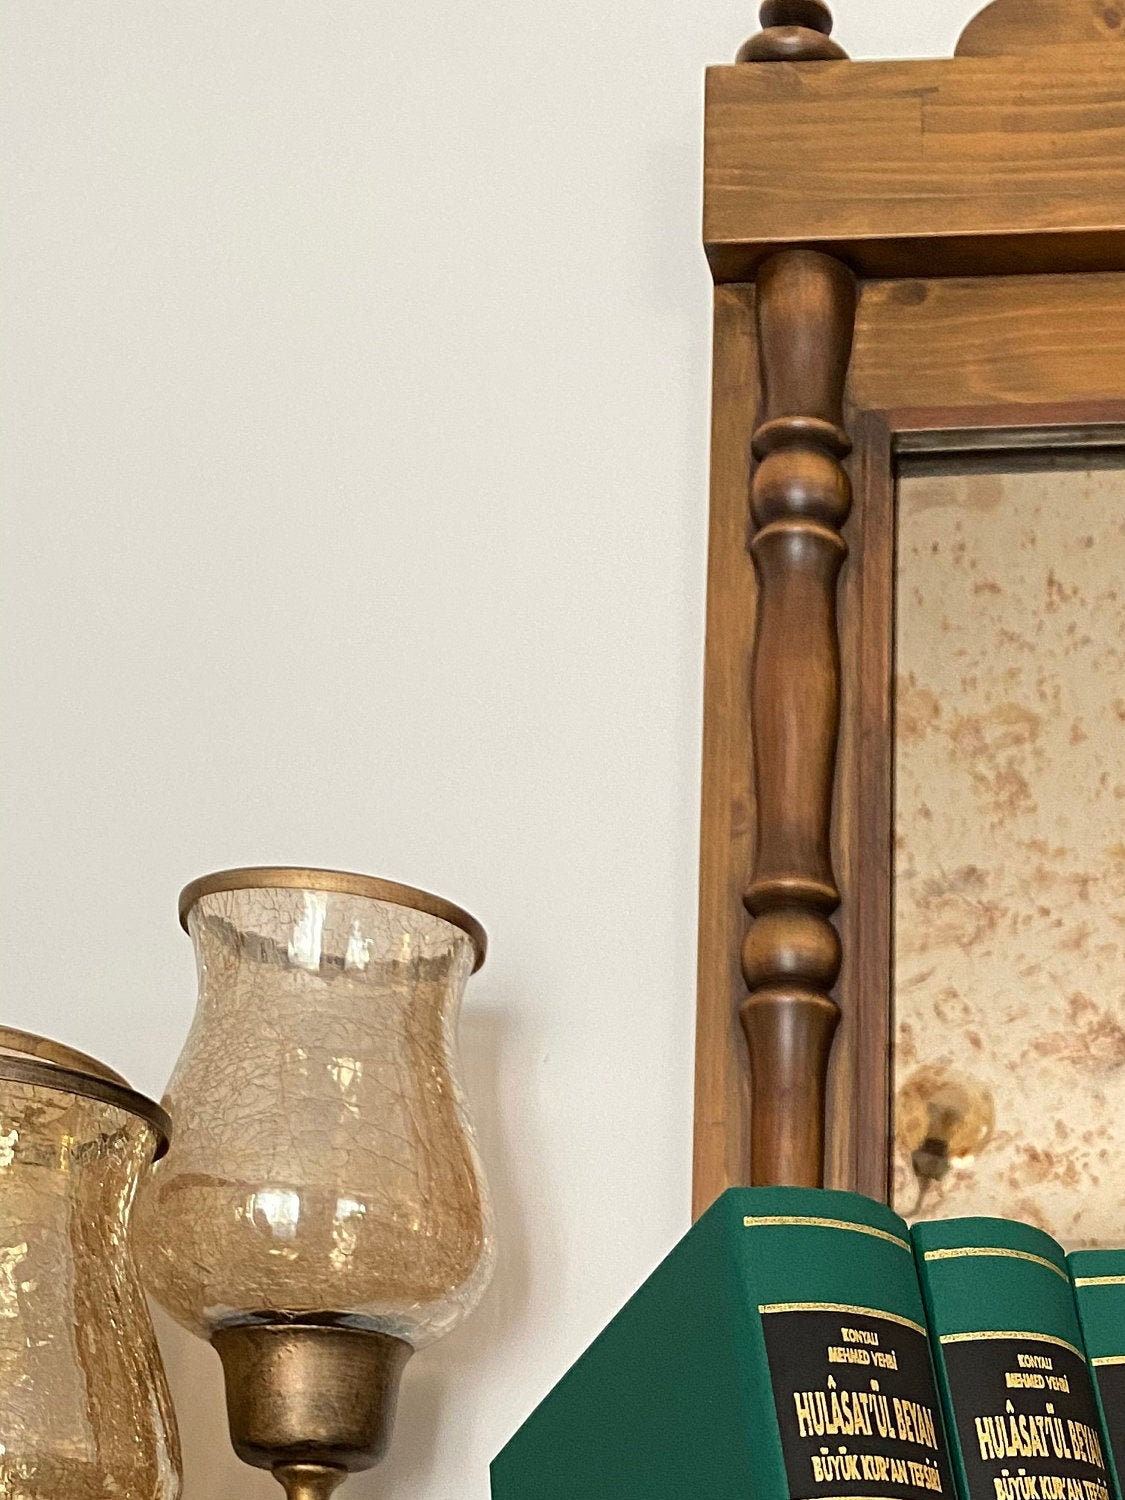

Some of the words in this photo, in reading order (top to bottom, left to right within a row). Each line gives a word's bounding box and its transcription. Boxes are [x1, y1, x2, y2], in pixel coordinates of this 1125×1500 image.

[841, 1328, 879, 1346] KONYALI
[828, 1346, 870, 1365] MEHMED
[1017, 1354, 1053, 1370] KONYALI
[1005, 1372, 1045, 1389] MEHMED
[793, 1374, 896, 1438] HULÂSAT'ÜL
[893, 1398, 938, 1450] BEYAN
[974, 1399, 1071, 1460] HULÂSAT'ÜL
[1067, 1419, 1105, 1470] BEYAN
[811, 1446, 861, 1482] BÜYÜK
[860, 1455, 909, 1484] KUR'AN
